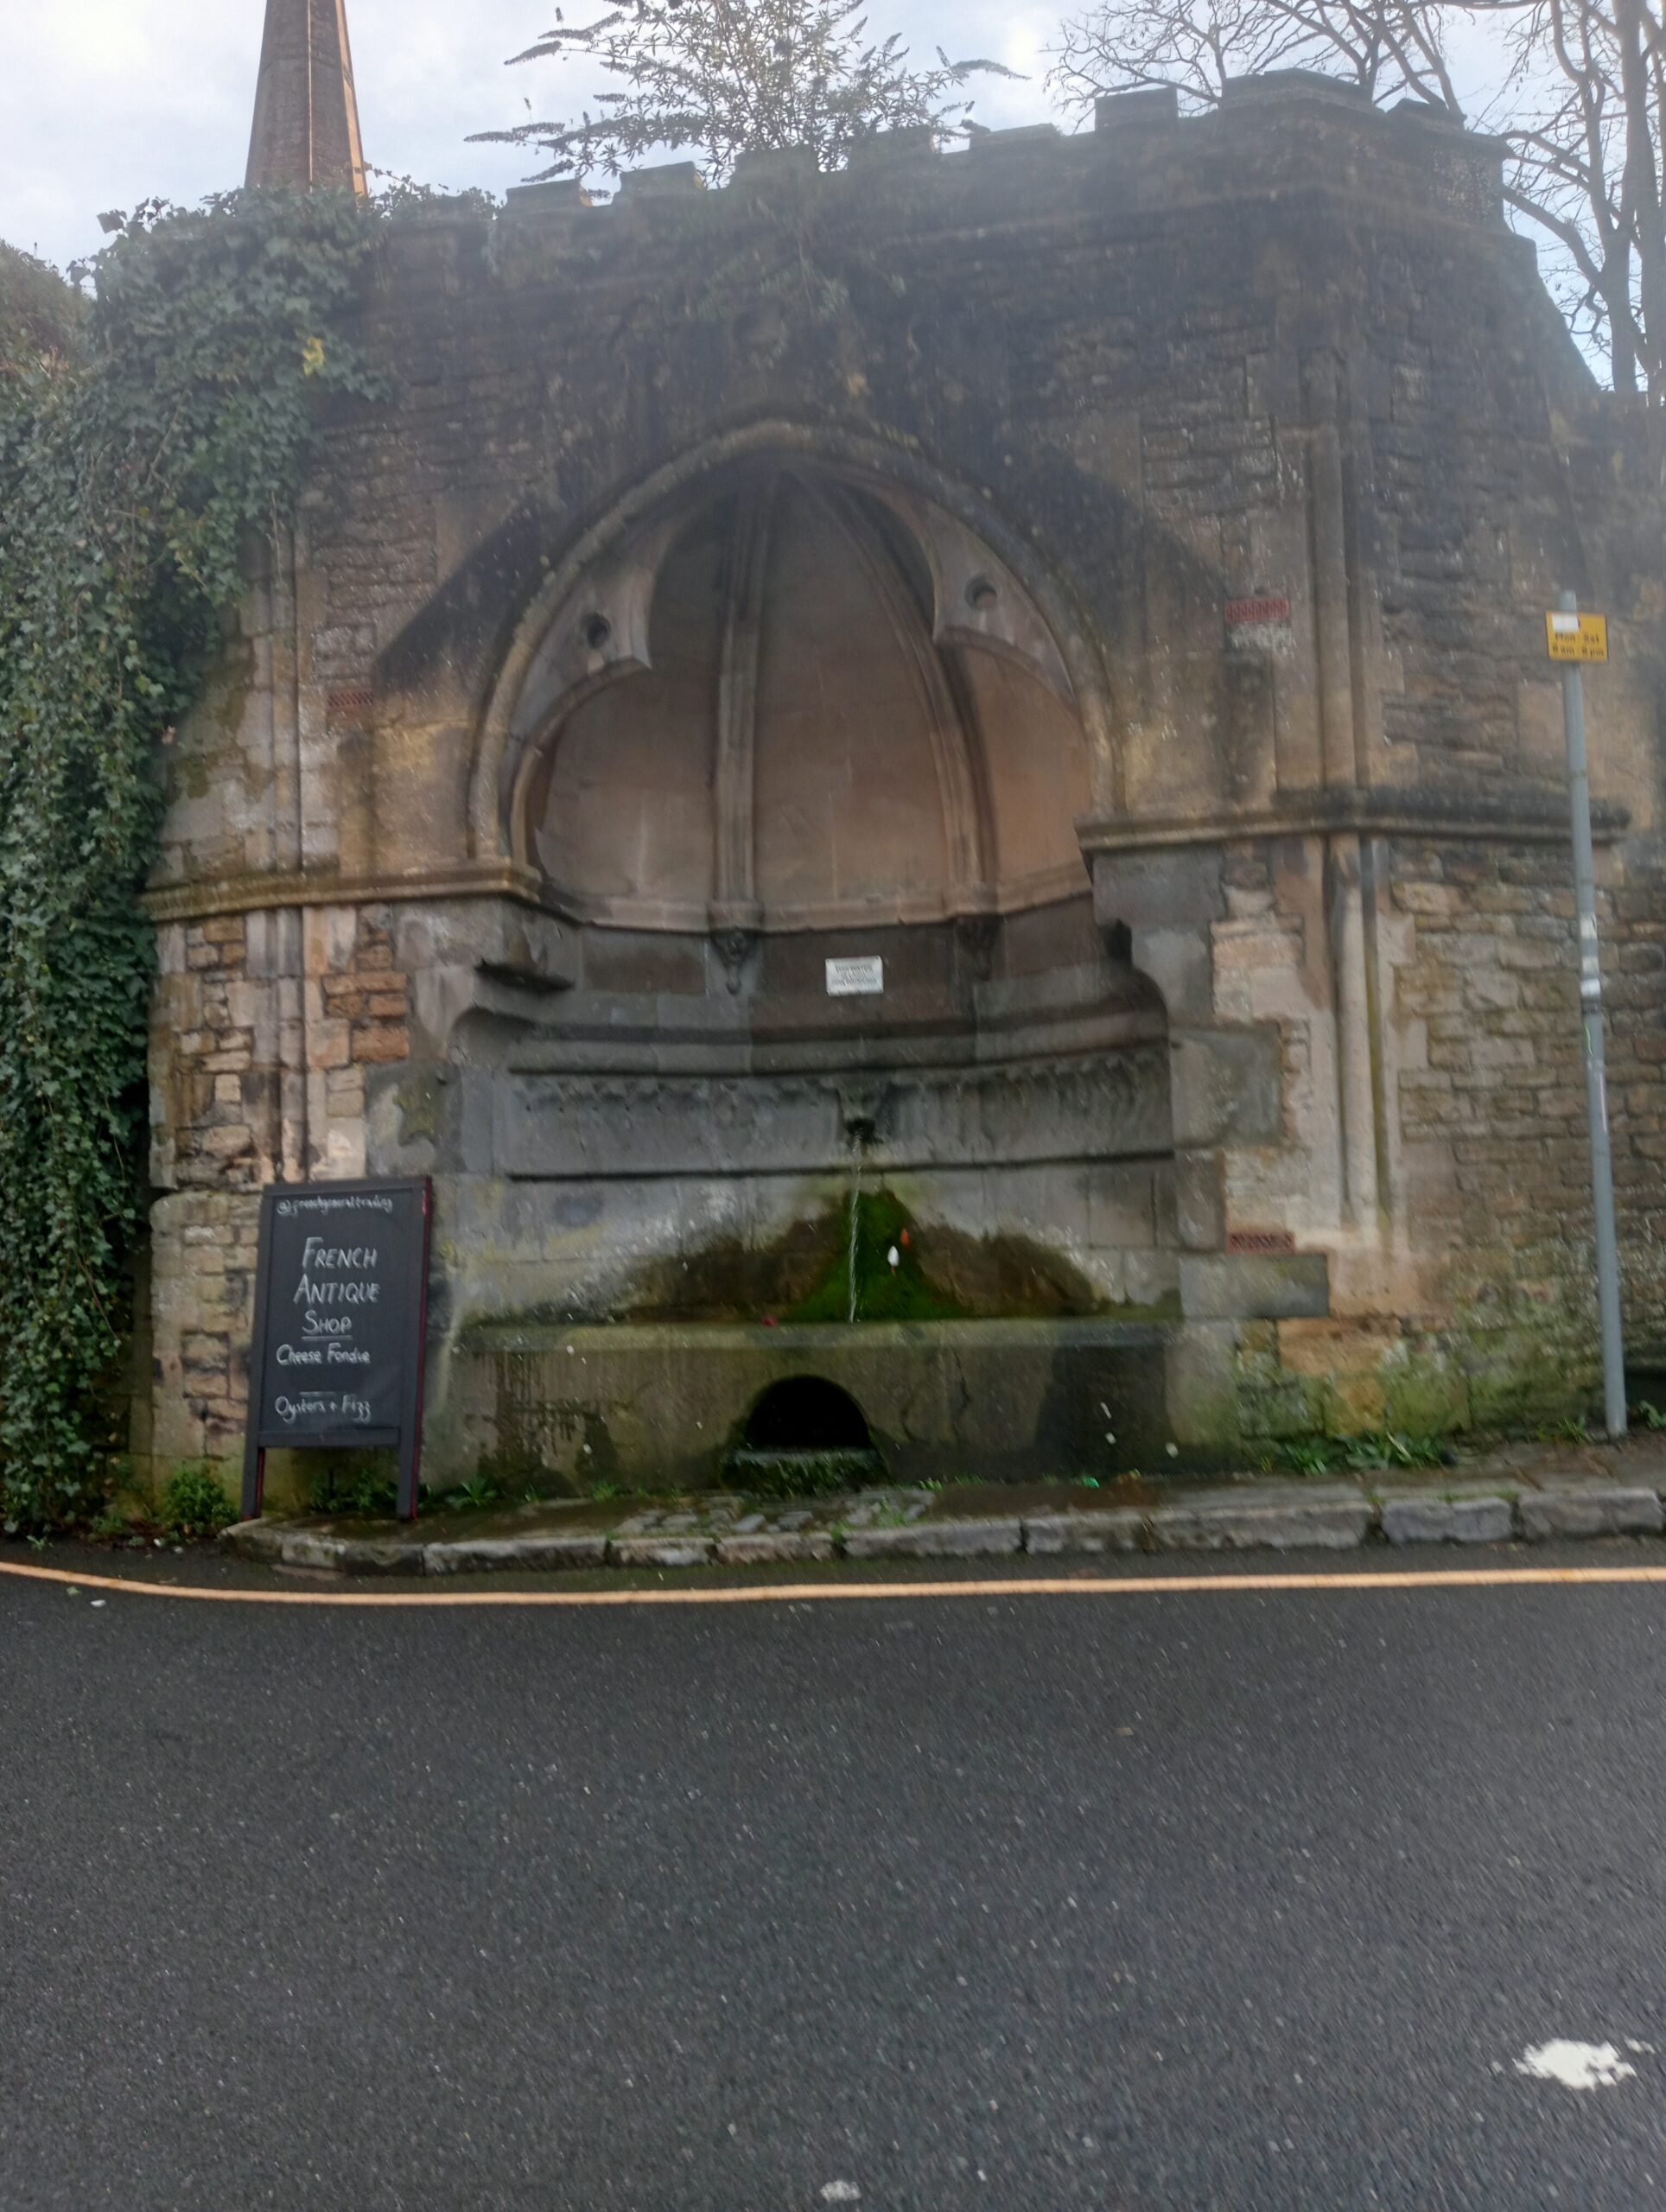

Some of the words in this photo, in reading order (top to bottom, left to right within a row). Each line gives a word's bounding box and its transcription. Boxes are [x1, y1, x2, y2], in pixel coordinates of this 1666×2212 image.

[302, 1236, 378, 1269] FRENCH
[293, 1274, 381, 1305] ANTIQUE
[302, 1309, 353, 1335] SHOP
[276, 1344, 322, 1365] Cheese
